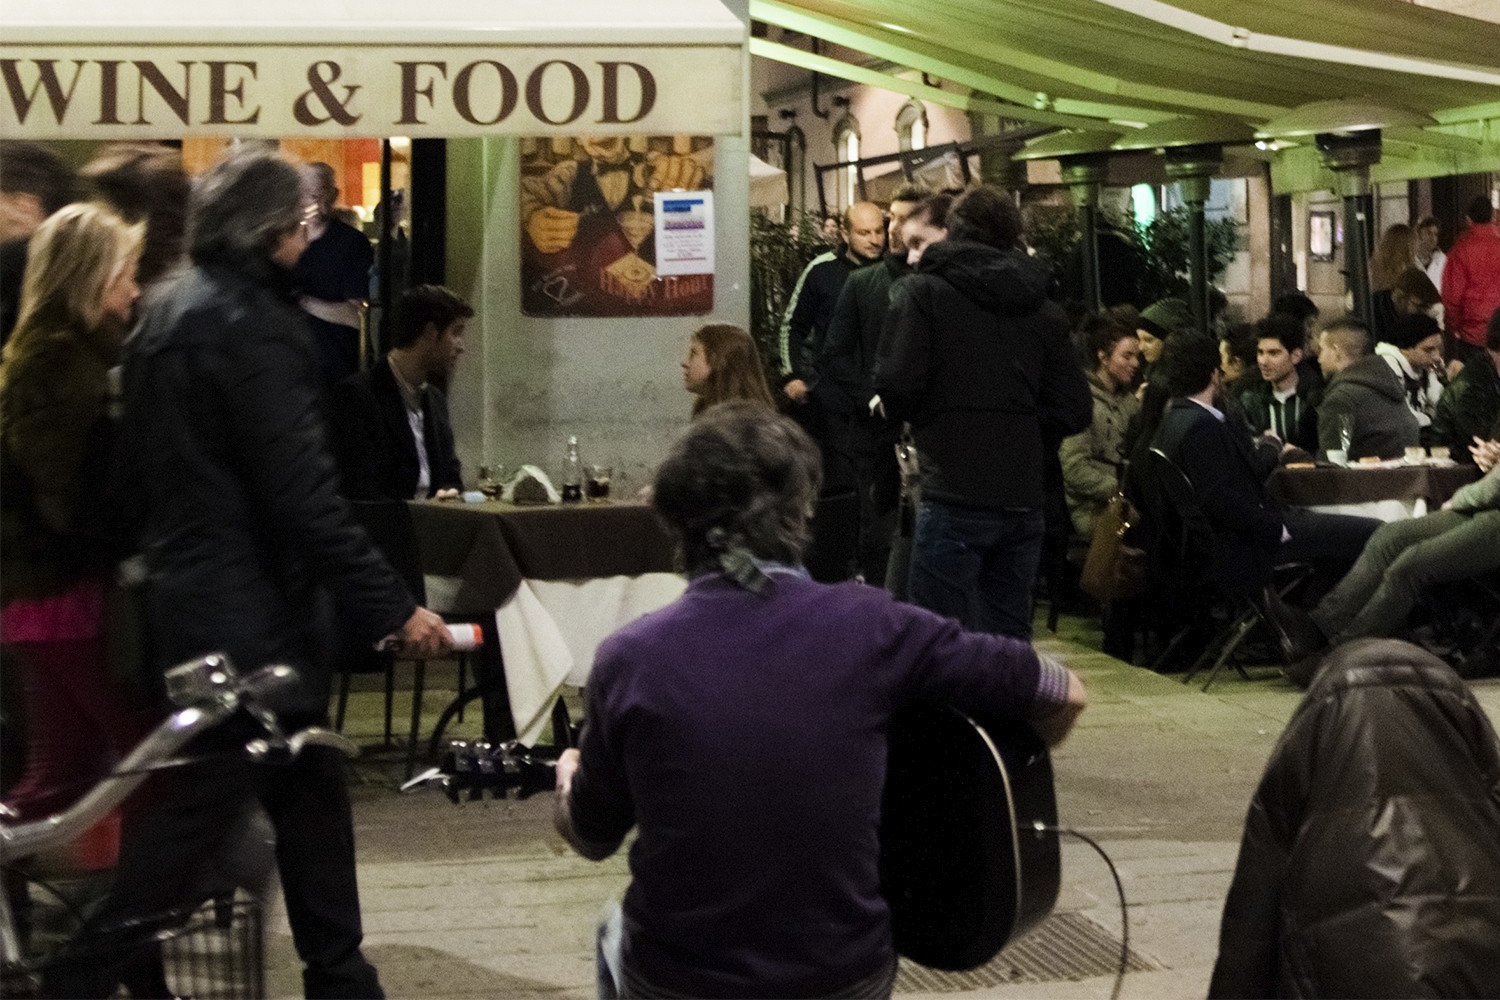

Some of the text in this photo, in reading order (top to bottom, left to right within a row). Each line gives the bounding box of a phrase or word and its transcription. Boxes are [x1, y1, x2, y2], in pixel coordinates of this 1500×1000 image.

[0, 59, 656, 127] WINE & FOOD
